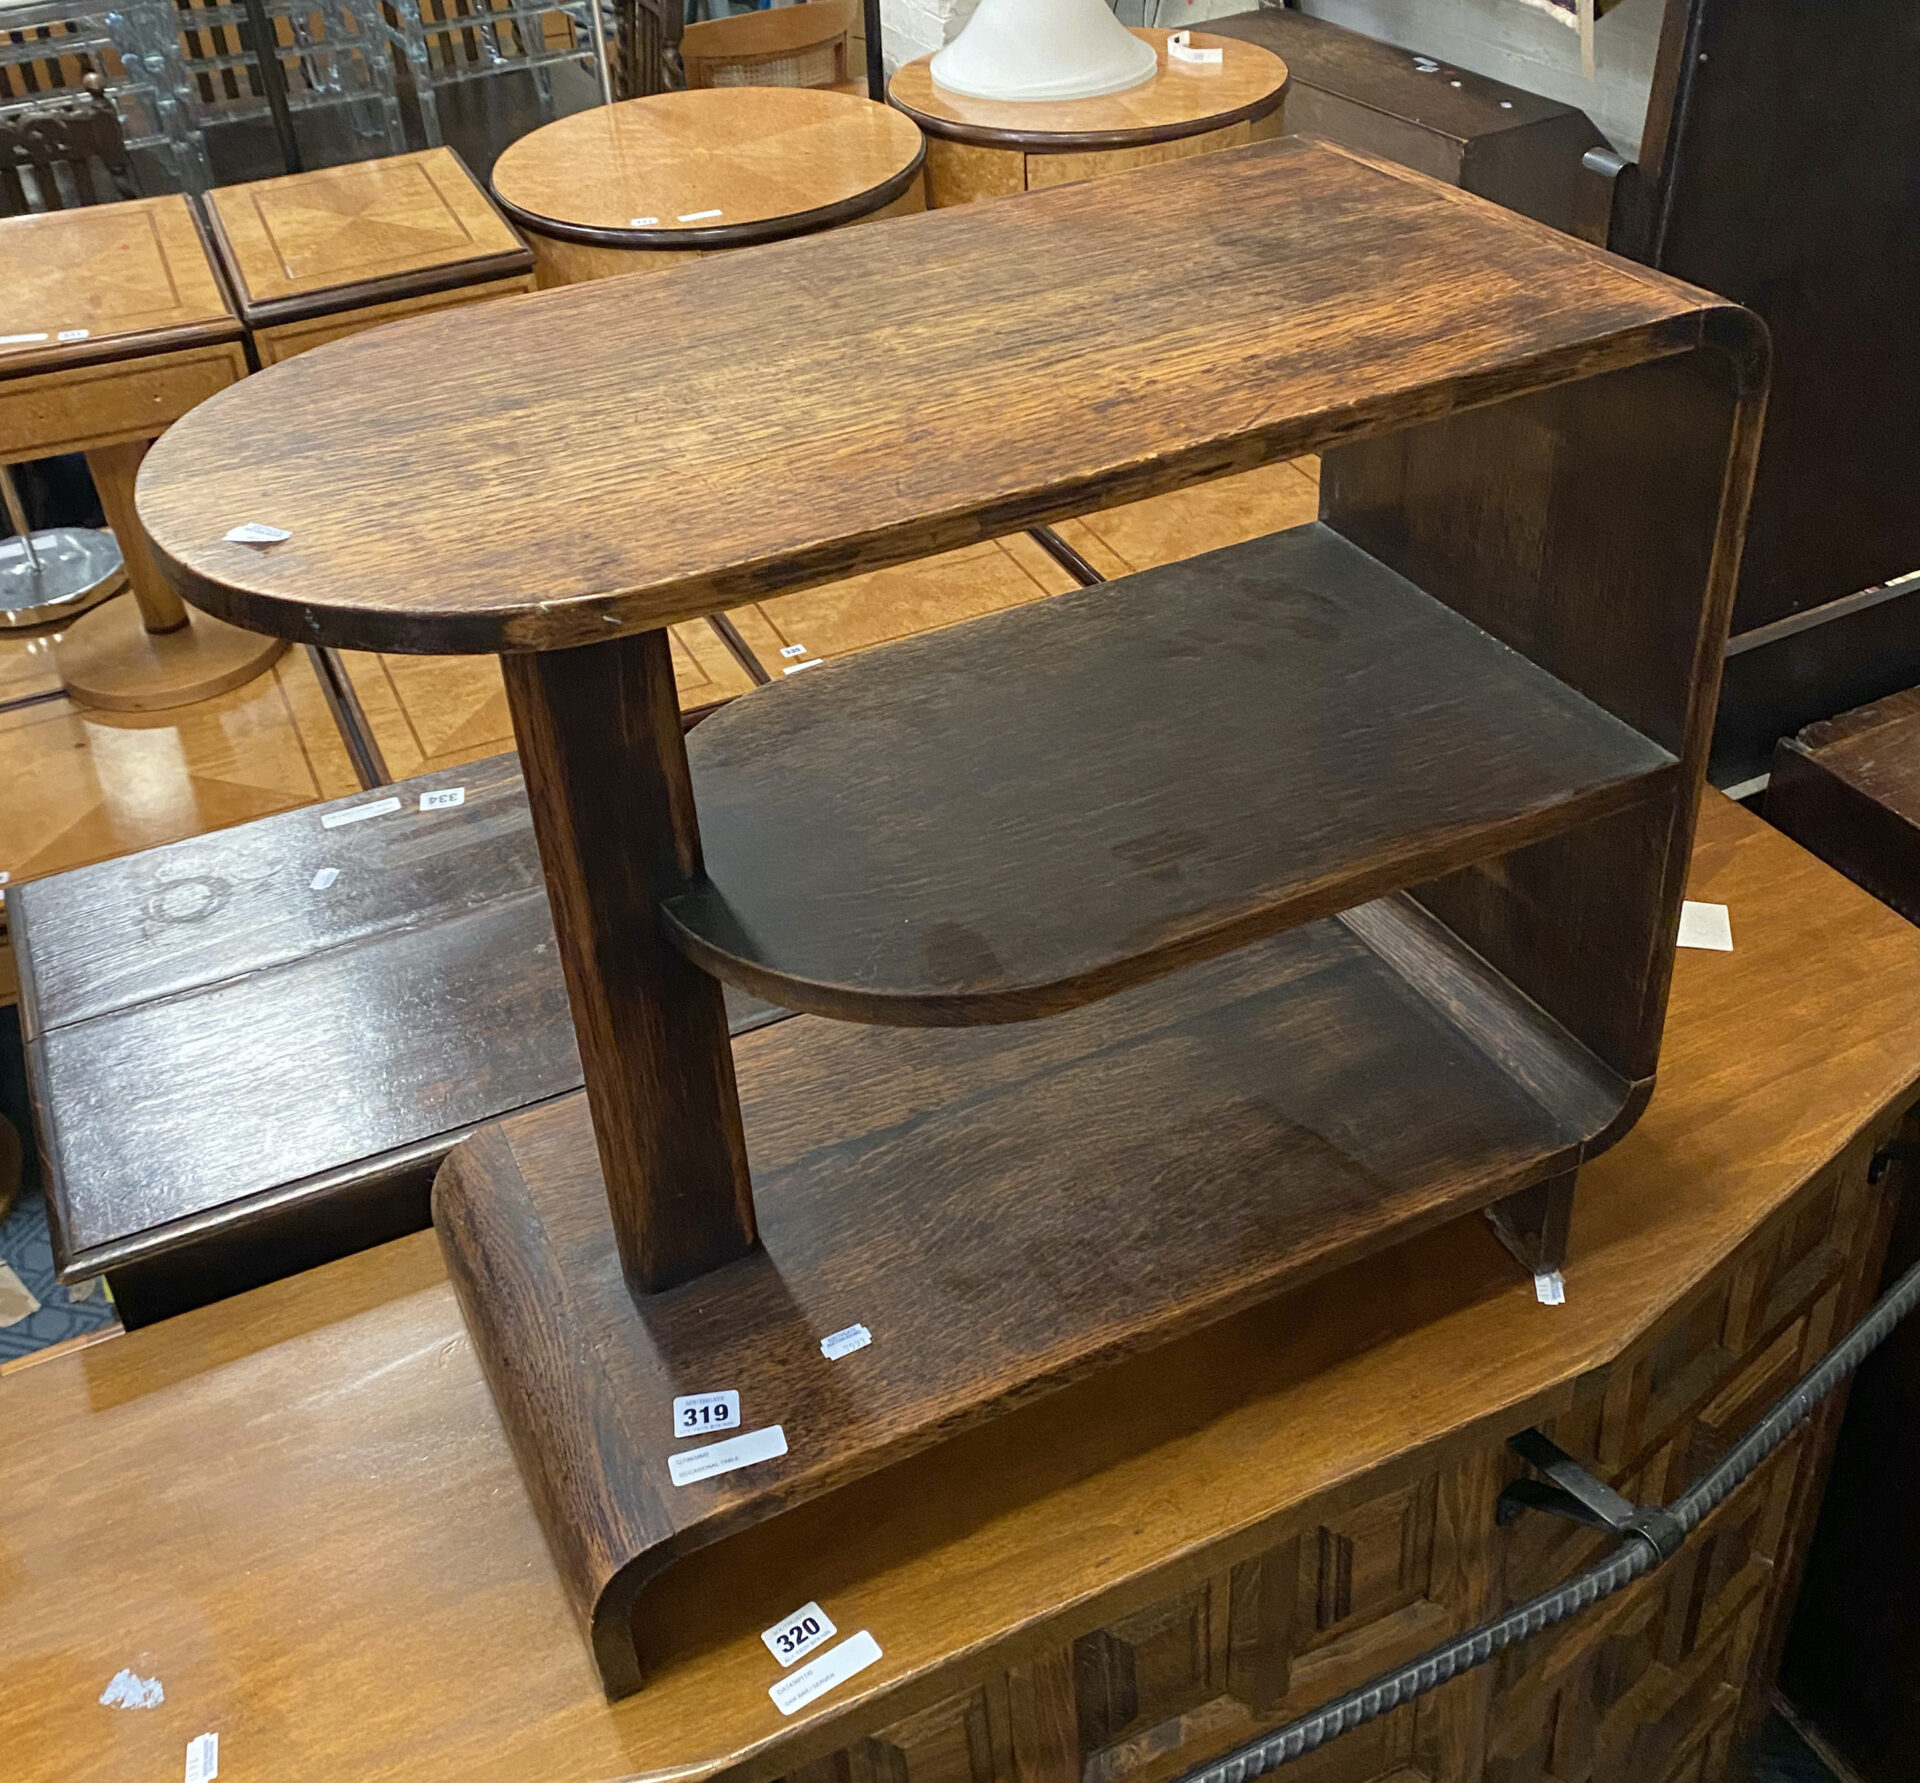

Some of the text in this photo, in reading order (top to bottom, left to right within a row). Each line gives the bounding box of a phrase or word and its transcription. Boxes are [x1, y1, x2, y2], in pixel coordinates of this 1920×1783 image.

[429, 792, 458, 804] 334
[683, 1404, 728, 1426] 319
[776, 1617, 820, 1653] 320
